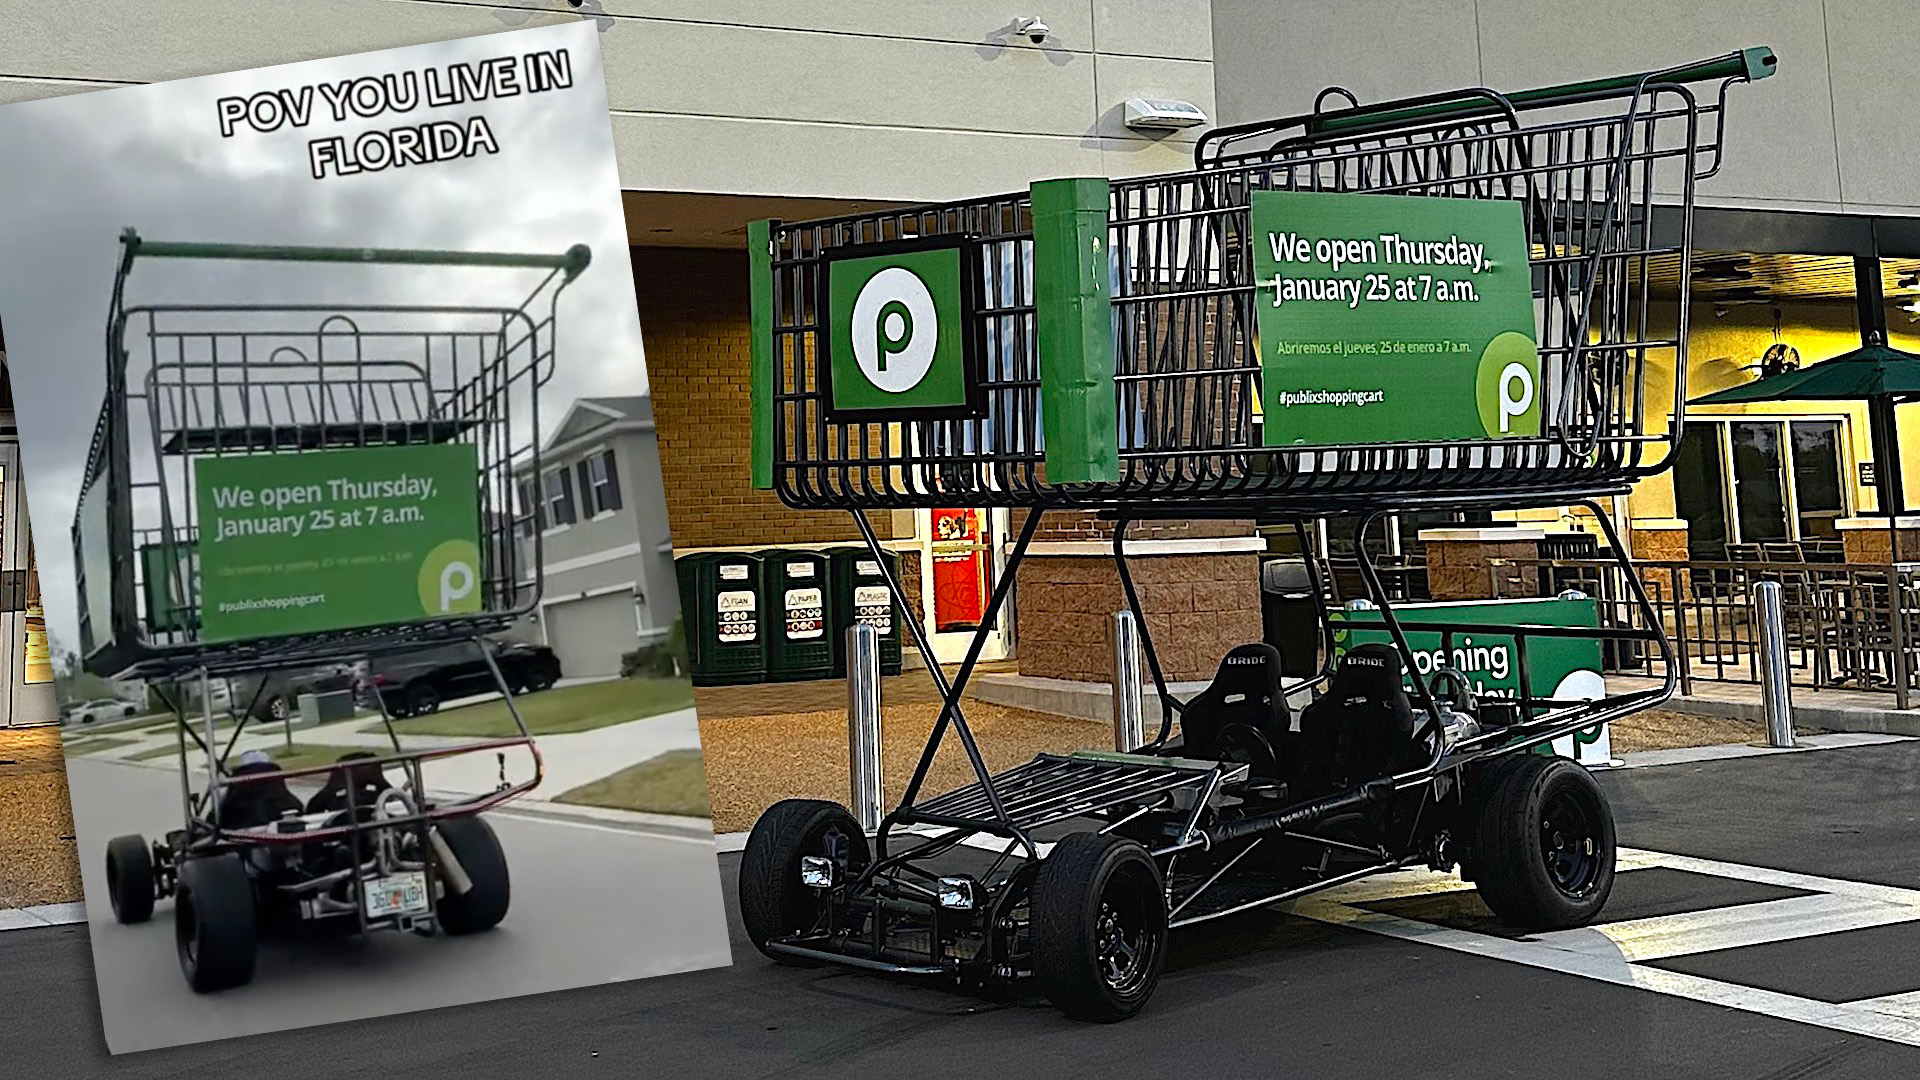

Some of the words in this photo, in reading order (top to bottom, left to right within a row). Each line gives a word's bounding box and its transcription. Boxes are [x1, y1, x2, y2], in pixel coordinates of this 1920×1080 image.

[1268, 232, 1310, 263] We
[1316, 237, 1377, 271] open
[1379, 234, 1490, 273] Thursday,
[1272, 273, 1361, 308] January
[1364, 274, 1391, 301] 25
[1394, 276, 1418, 301] at
[1418, 275, 1432, 301] 7
[1436, 279, 1479, 302] a.m.
[1277, 341, 1331, 354] Abriremos
[1332, 341, 1343, 354] el
[1344, 342, 1378, 357] jueves,
[1379, 341, 1393, 354] 25
[1393, 341, 1406, 353] de
[1407, 343, 1436, 353] enero
[1436, 344, 1443, 353] a
[1443, 341, 1450, 352] 7
[1279, 389, 1384, 407] #publixshoppingcart
[212, 486, 254, 509] We
[260, 484, 322, 511] open
[327, 474, 438, 501] Thursday,
[214, 516, 305, 542] January
[309, 510, 335, 530] 25
[339, 508, 362, 528] at
[365, 506, 380, 525] 7
[382, 505, 424, 524] a.m.
[219, 593, 325, 613] #publixshoppingcart
[1227, 656, 1267, 666] BRIDE
[1347, 656, 1385, 667] BRIDE
